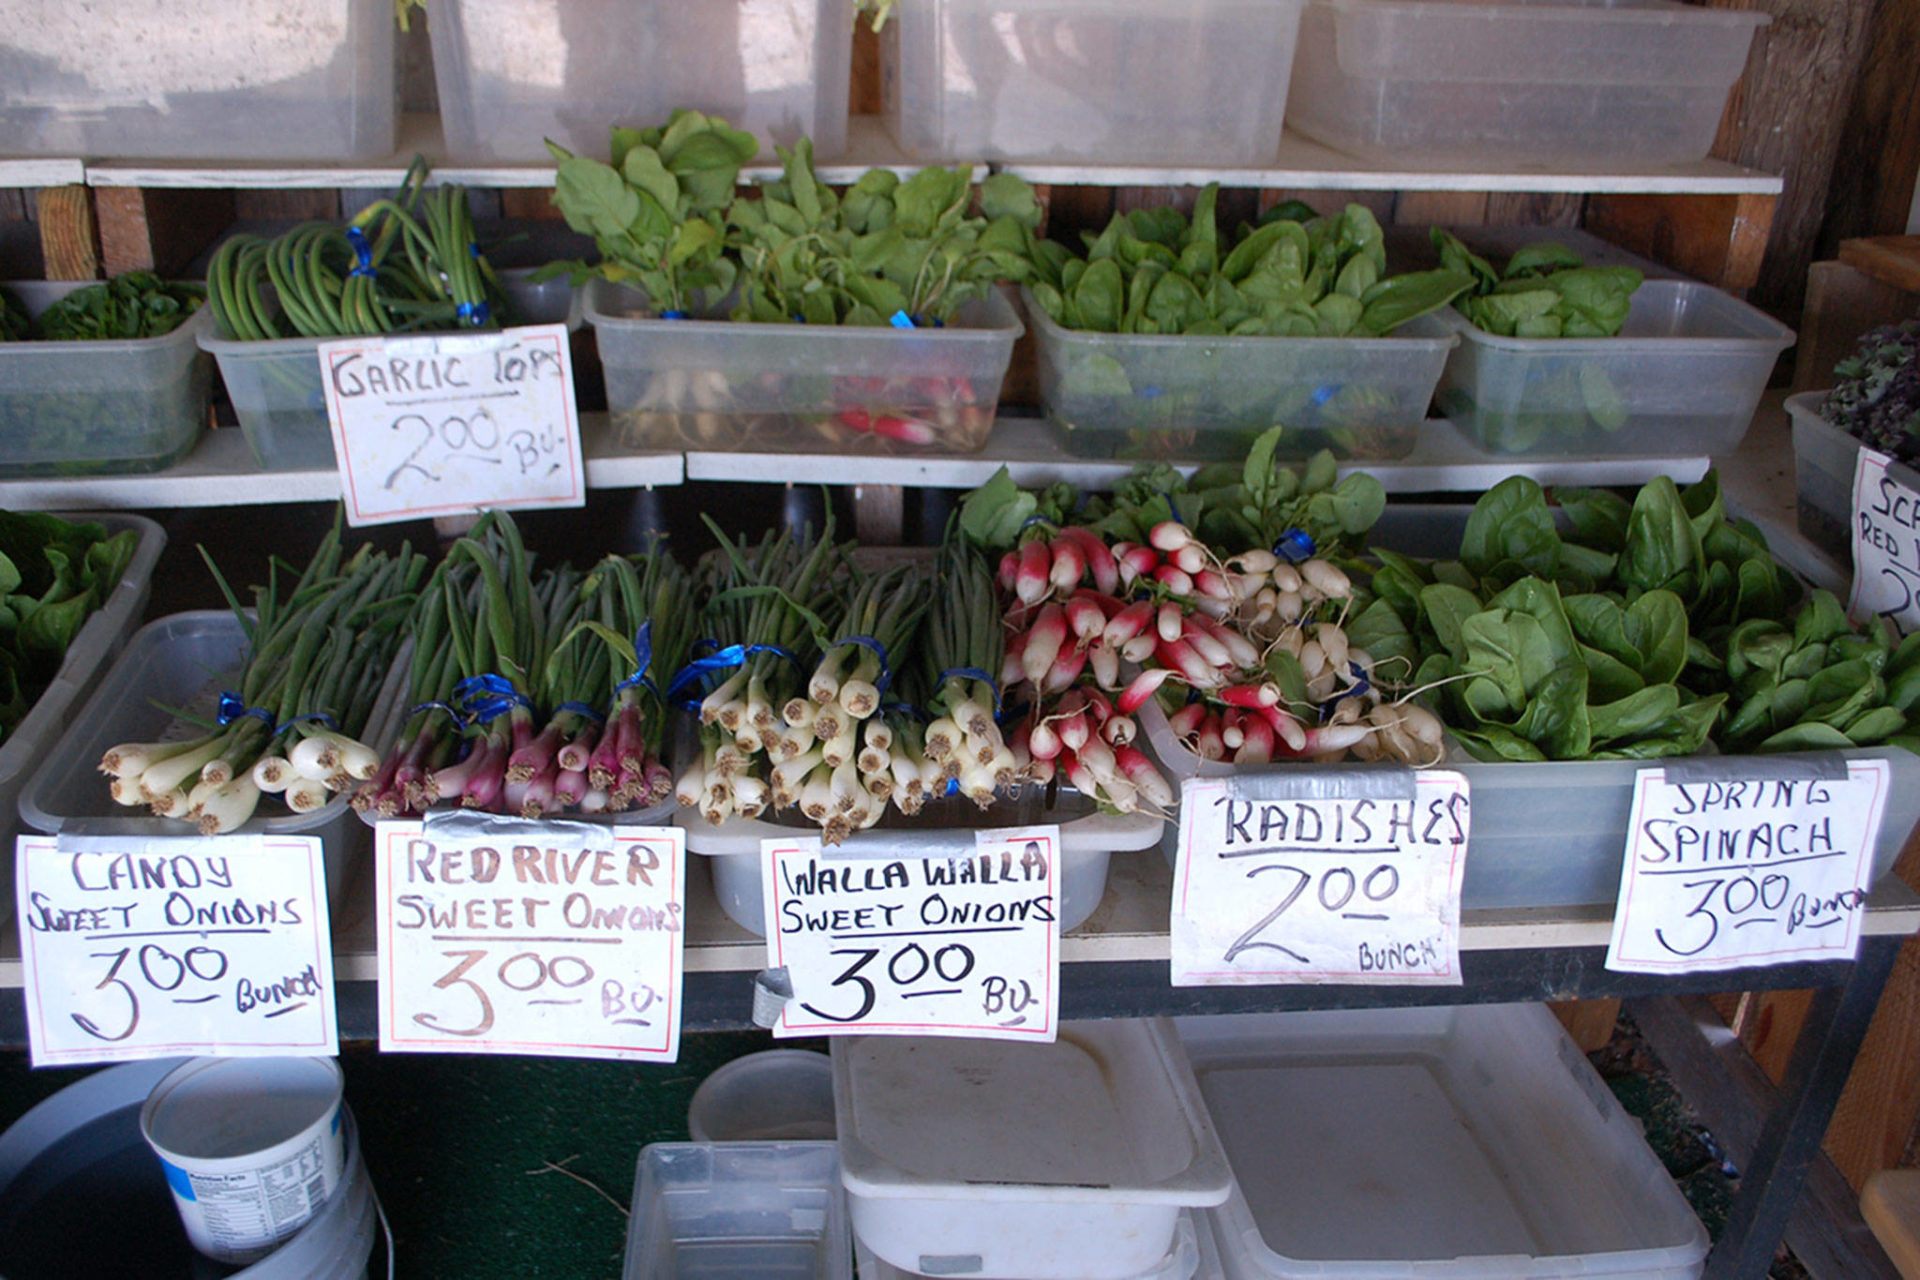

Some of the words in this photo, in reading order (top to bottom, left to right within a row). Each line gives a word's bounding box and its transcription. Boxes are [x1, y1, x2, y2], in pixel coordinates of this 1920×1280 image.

[332, 344, 470, 397] GARLIC
[1860, 511, 1899, 557] RED
[1213, 792, 1470, 845] RADISHES
[1640, 816, 1832, 863] SPINACH
[72, 853, 233, 891] CANDY
[407, 839, 502, 885] RED
[512, 845, 660, 887] RIVER
[781, 858, 910, 896] WALLA
[922, 841, 1049, 886] WALLA
[27, 891, 138, 932] SWEET
[165, 891, 302, 926] ONIONS
[397, 894, 550, 930] SWEET
[781, 899, 905, 934] SWEET
[920, 893, 1056, 925] ONIONS
[1223, 864, 1400, 964] 200
[1655, 874, 1790, 956] 300
[71, 944, 228, 1041] 300
[412, 950, 595, 1037] 300
[799, 942, 976, 1022] 300
